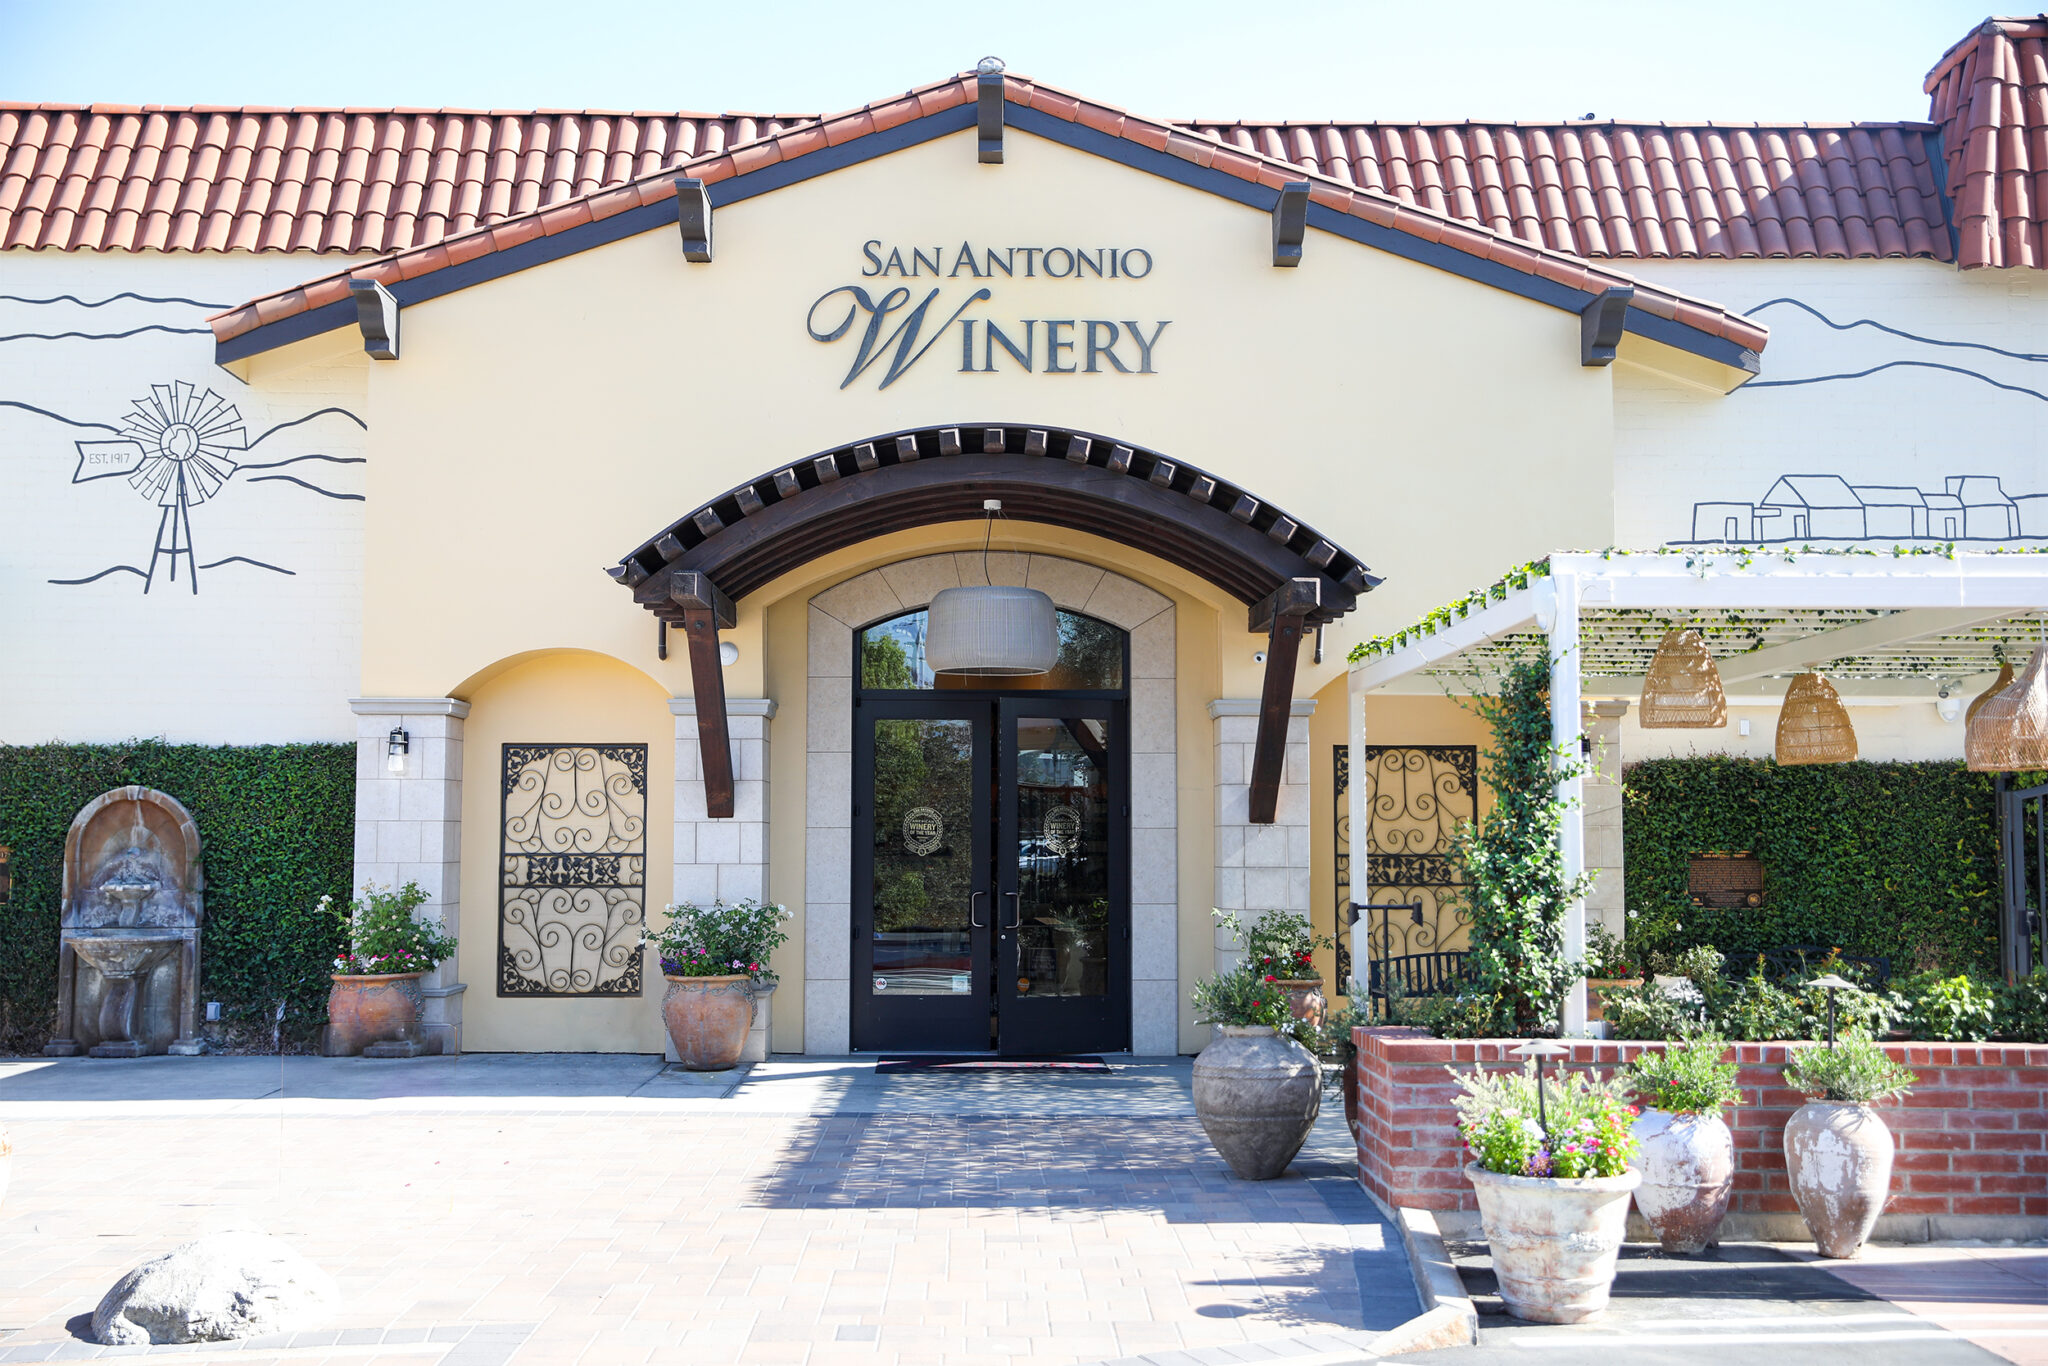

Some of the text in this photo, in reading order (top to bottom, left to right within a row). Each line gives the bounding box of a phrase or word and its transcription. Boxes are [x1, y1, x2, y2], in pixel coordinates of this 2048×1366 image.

[862, 240, 1153, 279] SAN ANTONIO
[807, 285, 1173, 391] WINERY
[89, 452, 130, 464] EST. 1917
